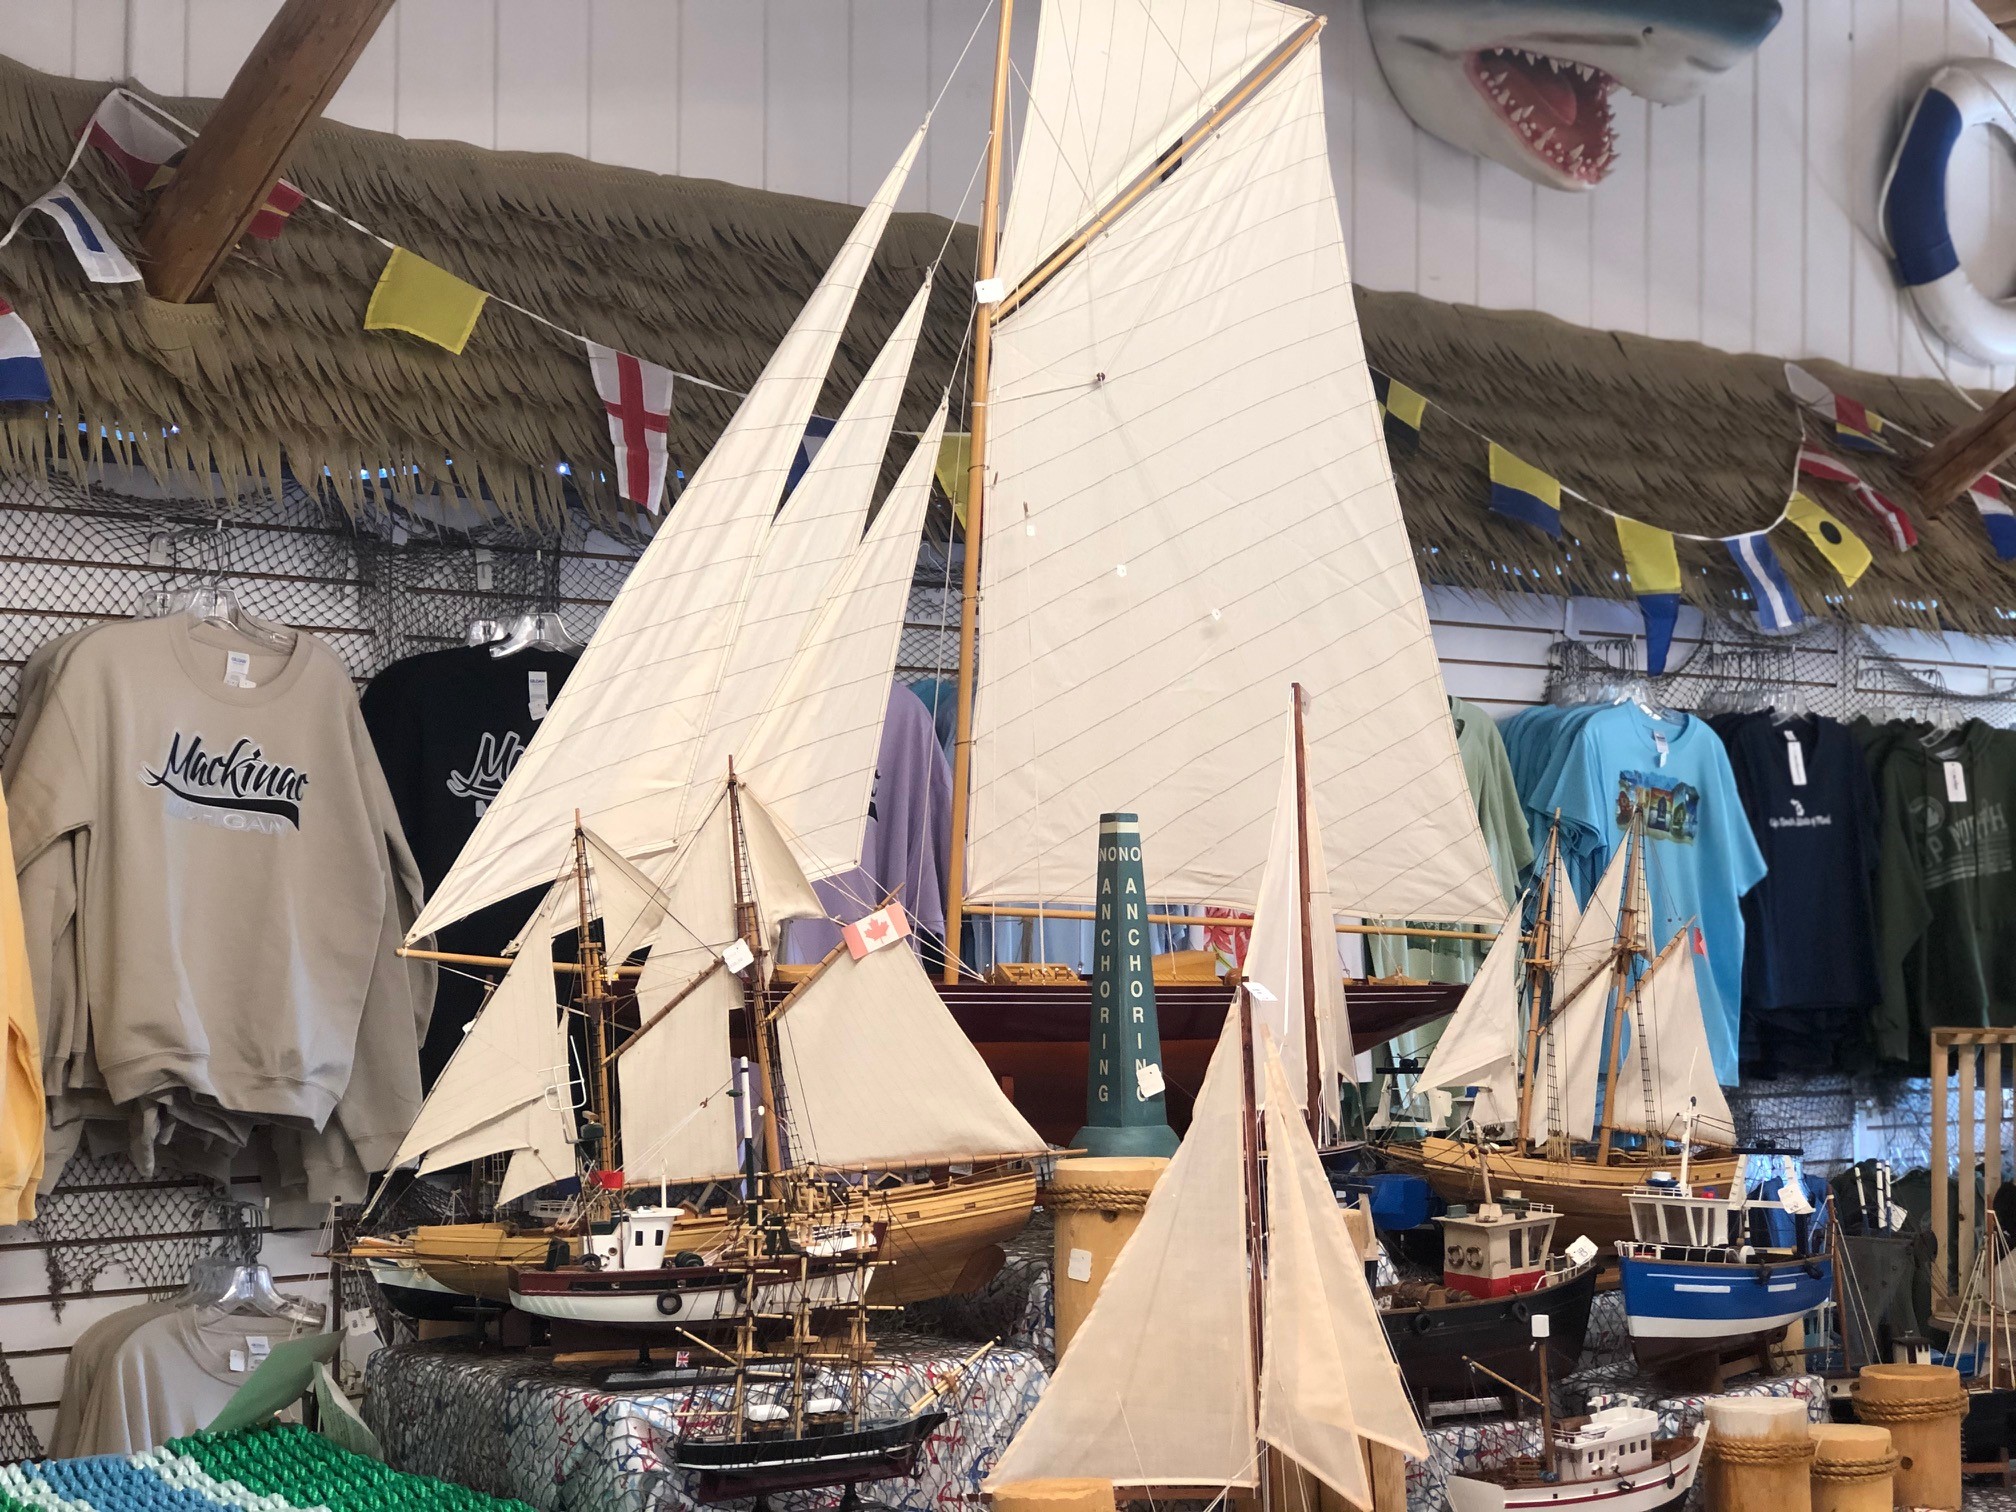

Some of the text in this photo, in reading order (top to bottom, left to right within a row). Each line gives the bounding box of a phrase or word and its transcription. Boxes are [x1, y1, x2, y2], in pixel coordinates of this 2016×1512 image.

[141, 729, 310, 802] Mackinac
[1099, 845, 1117, 861] NO
[1118, 845, 1141, 862] NO
[1098, 878, 1112, 1102] ANCHORING
